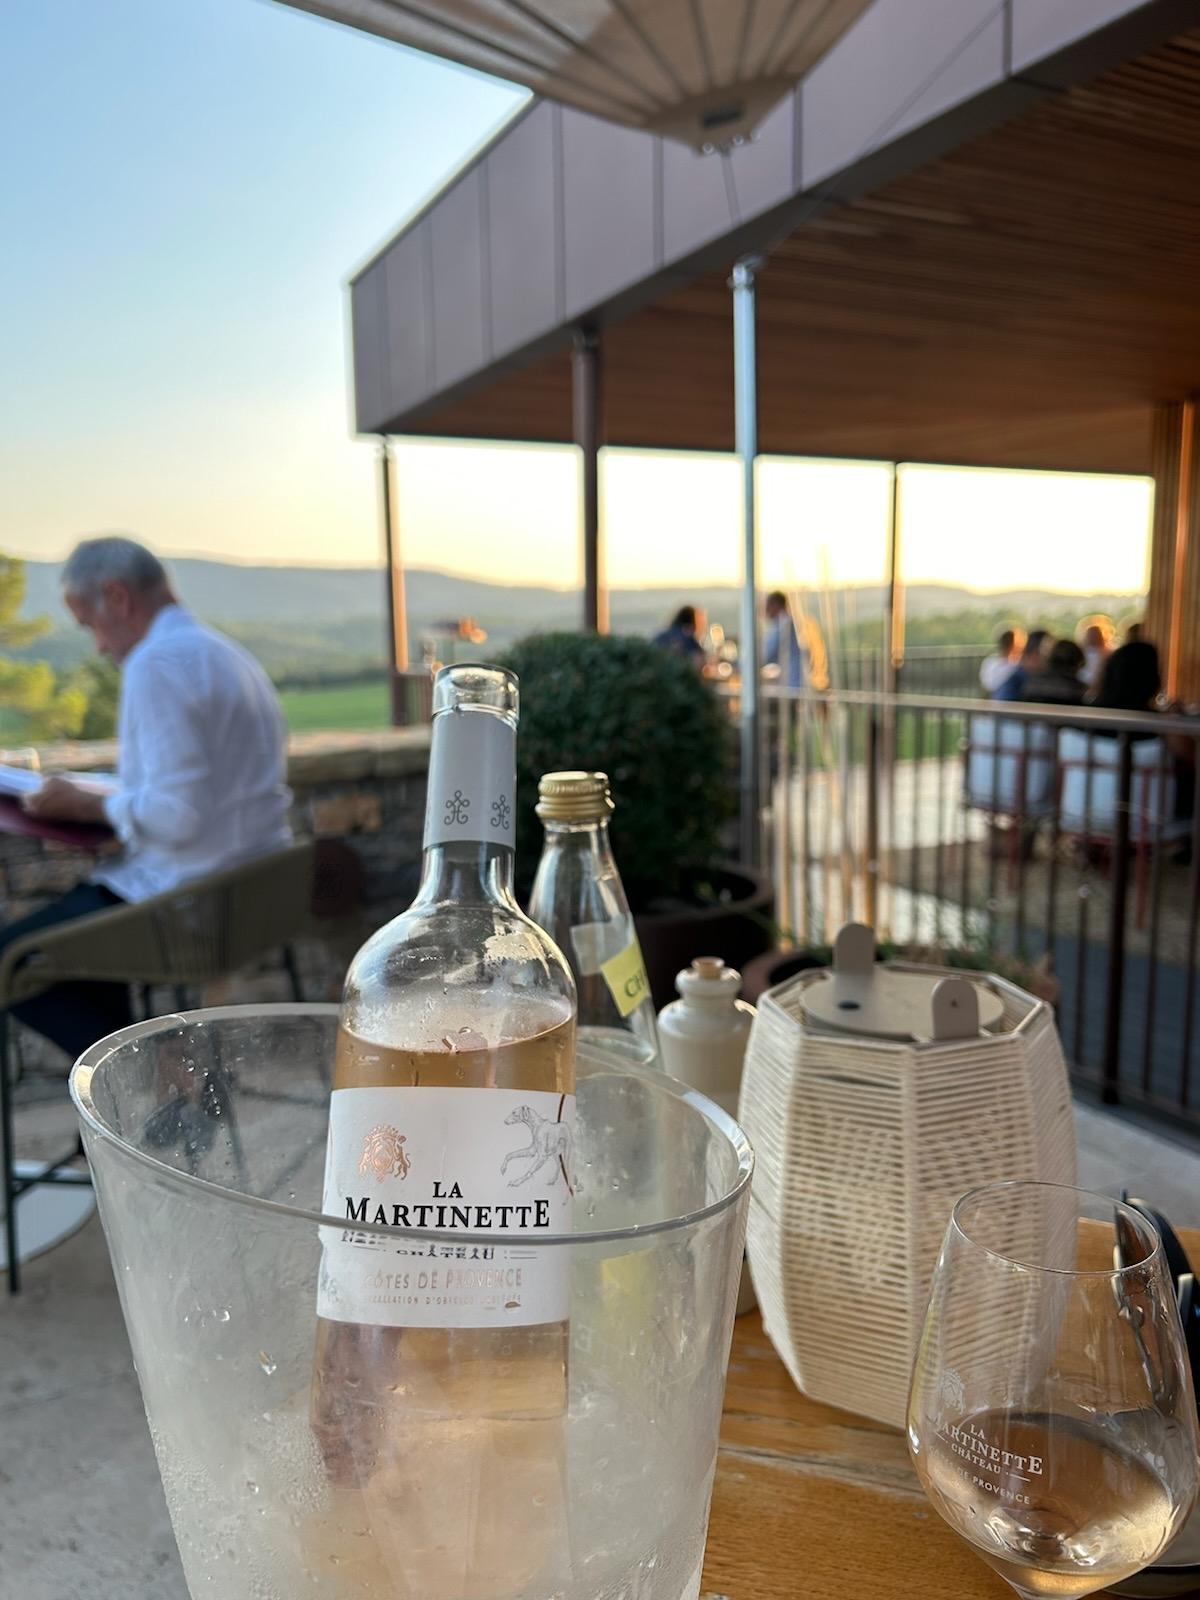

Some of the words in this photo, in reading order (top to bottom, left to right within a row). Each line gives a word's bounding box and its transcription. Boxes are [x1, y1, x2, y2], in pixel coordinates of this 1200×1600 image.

[432, 1181, 463, 1198] LA
[345, 1197, 549, 1228] MARTINETTE
[418, 1272, 438, 1289] DE
[446, 1268, 522, 1289] PROVENCE
[970, 1423, 986, 1439] LA
[951, 1444, 1001, 1474] CHÂTEAU
[972, 1475, 1031, 1505] PROVENCE
